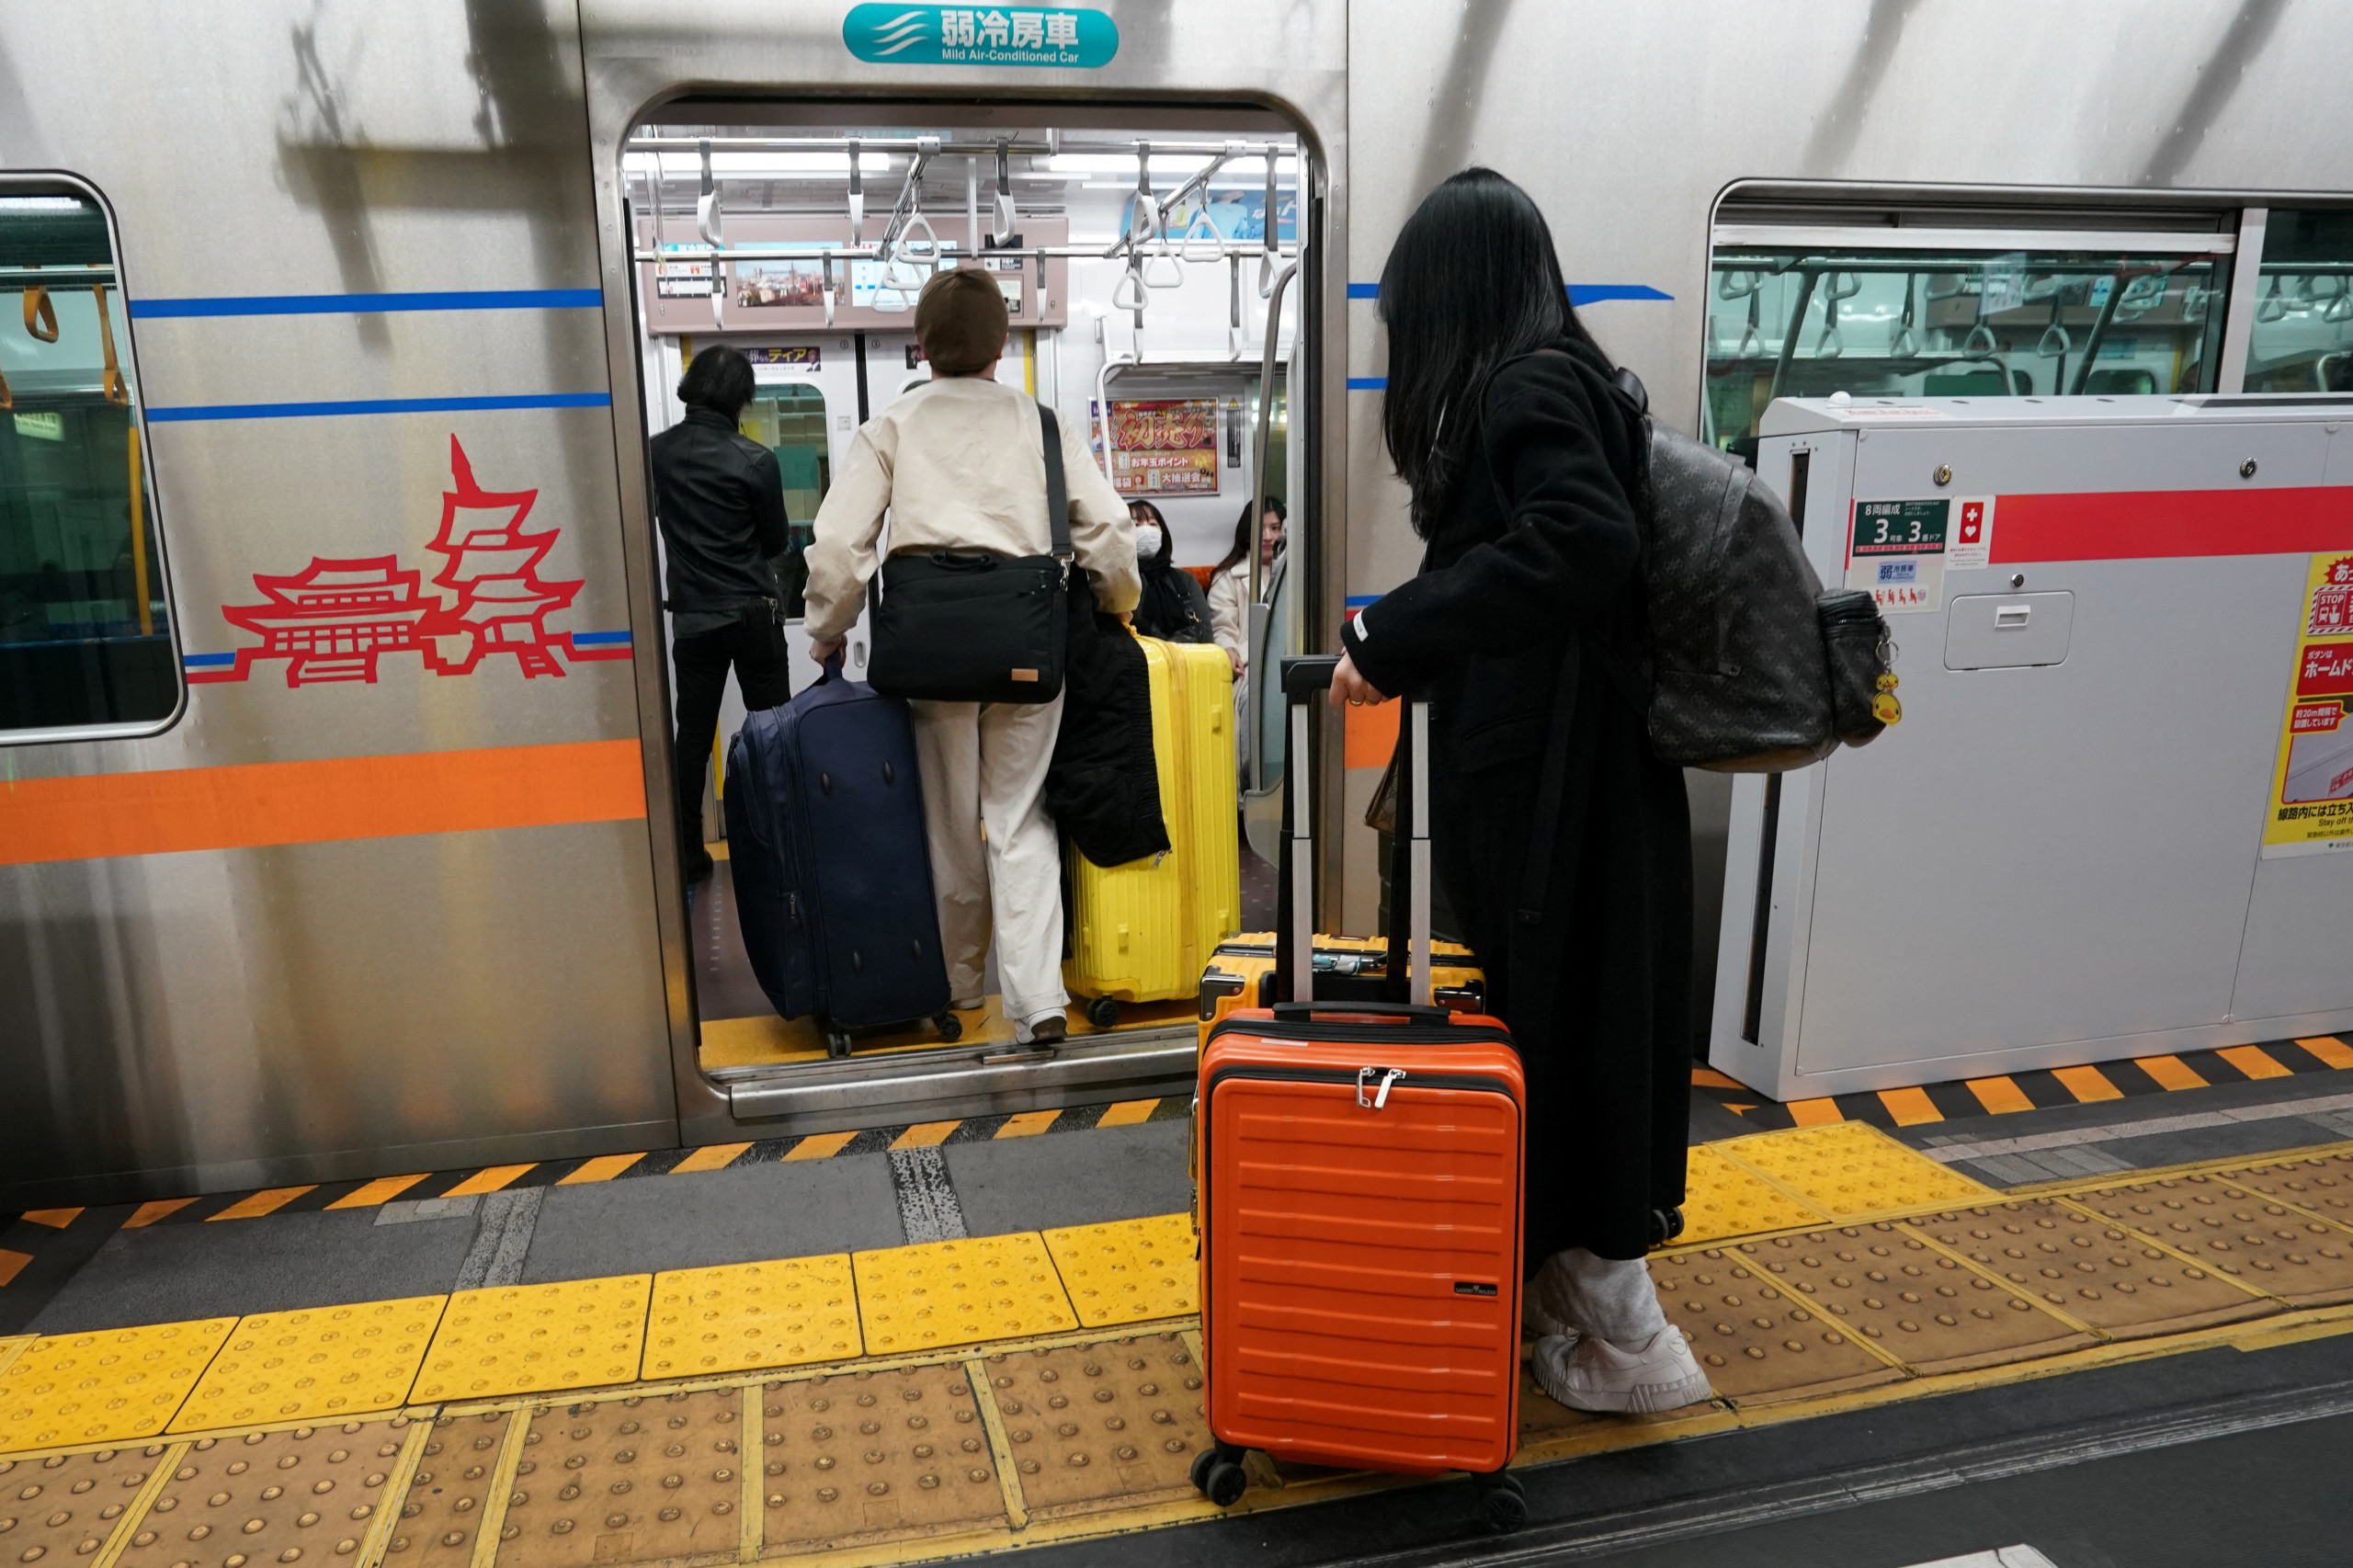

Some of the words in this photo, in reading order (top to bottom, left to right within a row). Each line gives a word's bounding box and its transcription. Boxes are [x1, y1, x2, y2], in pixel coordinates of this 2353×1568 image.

[940, 9, 1079, 50] 弱冷房車
[942, 48, 965, 60] Mild
[969, 49, 1056, 62] Air-Conditioned
[1059, 51, 1079, 63] Car
[1120, 410, 1205, 451] 初売り
[1131, 456, 1188, 469] お年玉ポイント
[1865, 504, 1901, 516] 8両編成
[2320, 594, 2345, 605] STOP
[2307, 649, 2333, 660] ボタンは
[2304, 658, 2353, 678] ホームド
[2296, 707, 2338, 719] 約20m間隔で
[2293, 717, 2336, 729] 設置しています
[2318, 818, 2336, 828] Stay
[2336, 816, 2347, 825] off
